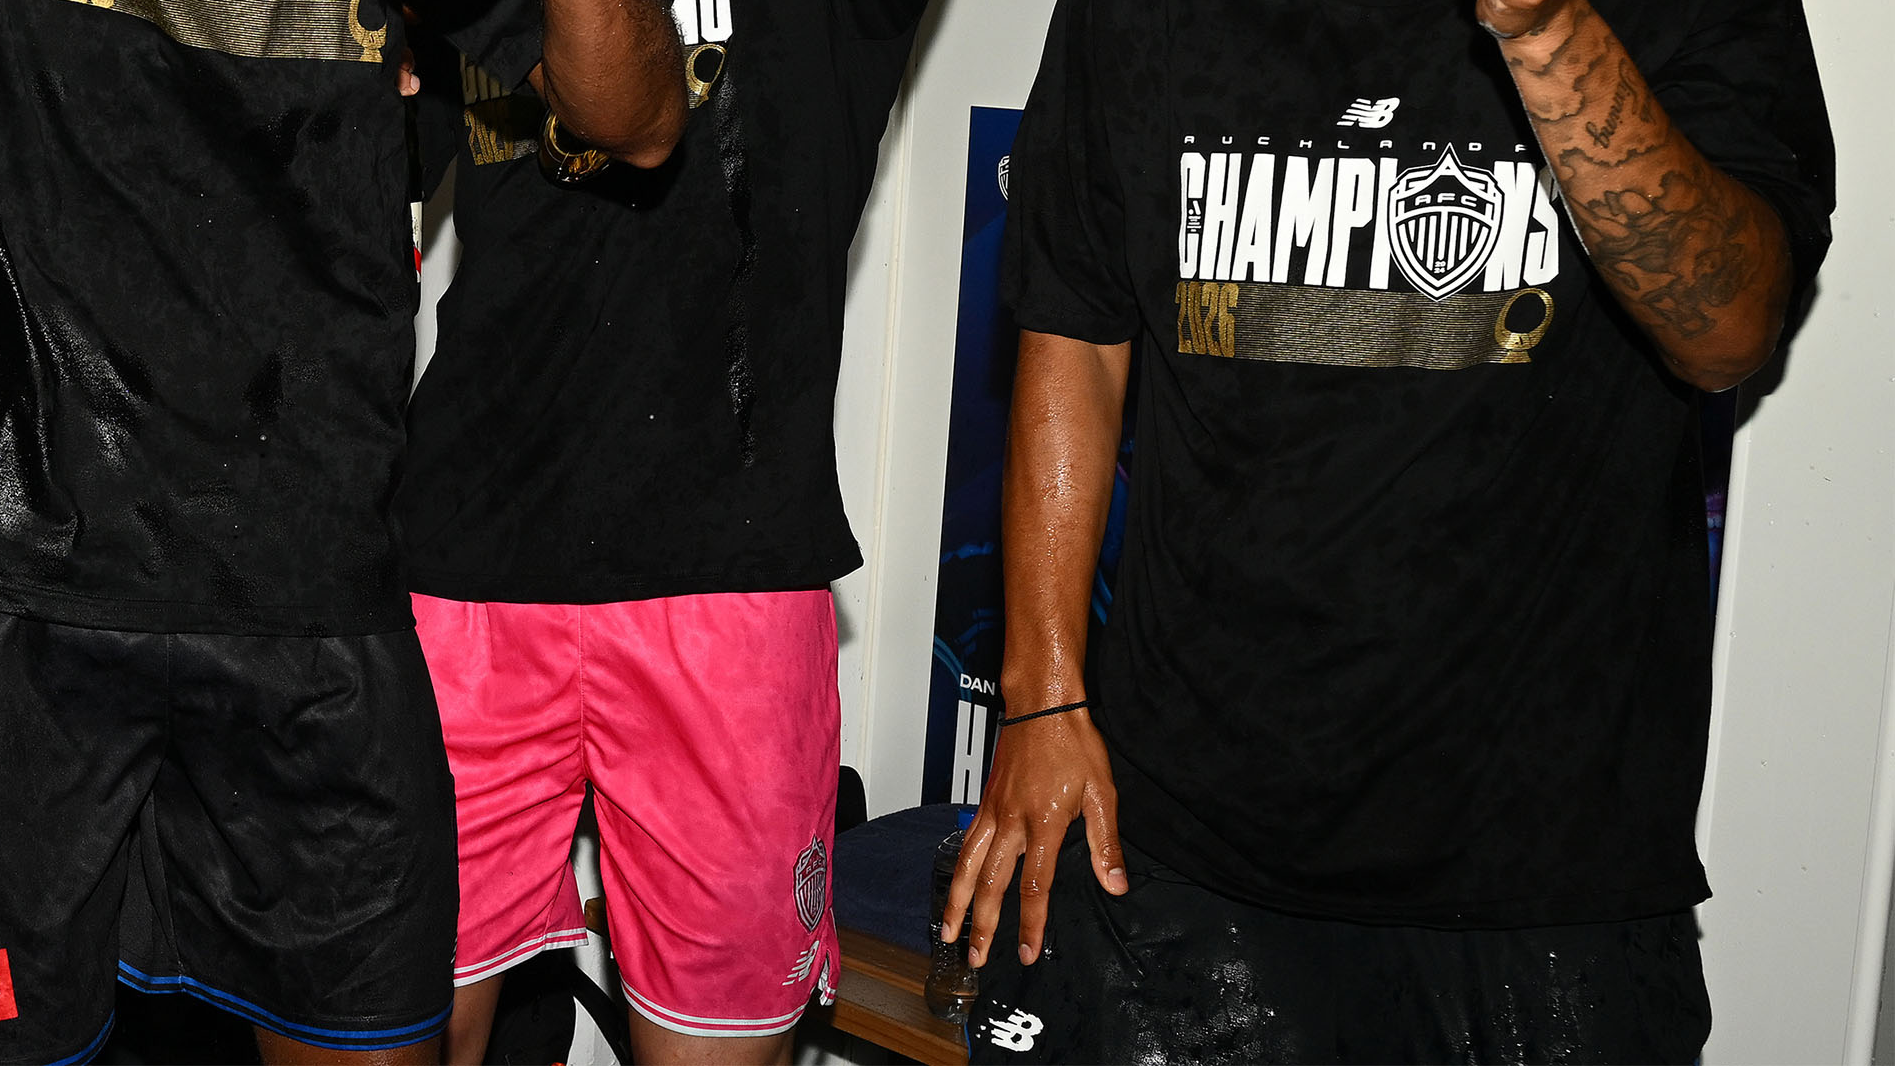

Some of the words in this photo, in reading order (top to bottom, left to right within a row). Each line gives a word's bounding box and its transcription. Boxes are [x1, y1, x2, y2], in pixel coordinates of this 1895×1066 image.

[1415, 193, 1478, 208] AFC
[1175, 281, 1238, 359] 2026
[960, 673, 996, 696] DAN
